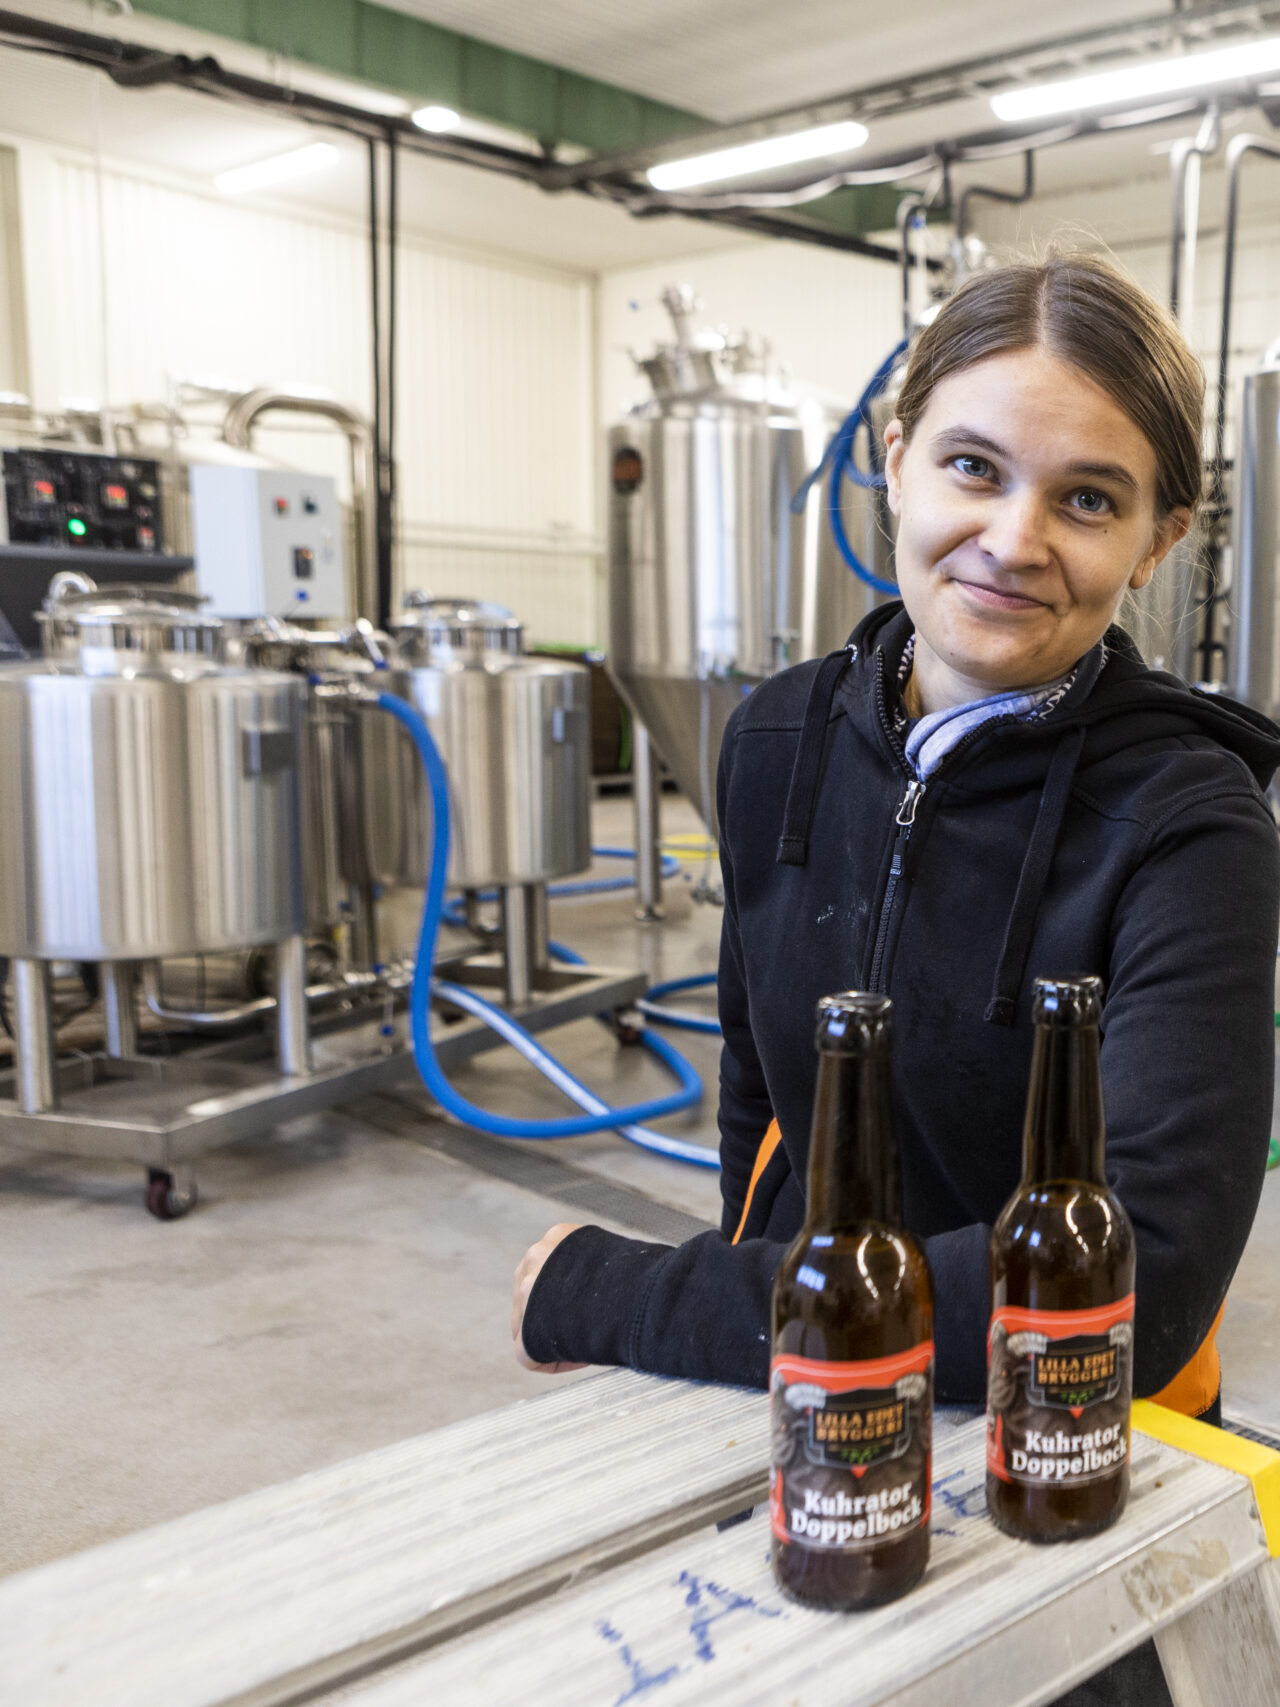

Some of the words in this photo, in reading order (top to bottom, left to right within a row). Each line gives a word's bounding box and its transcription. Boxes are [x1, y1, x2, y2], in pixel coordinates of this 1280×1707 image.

[1037, 1356, 1080, 1372] LILLA
[1037, 1362, 1115, 1385] BRYGGERI
[815, 1411, 863, 1427] LILLA
[1024, 1422, 1121, 1454] Kuhrator
[1011, 1437, 1128, 1481] Doppelbock
[804, 1480, 913, 1517] Kuhrator
[791, 1495, 922, 1545] Doppelbock
